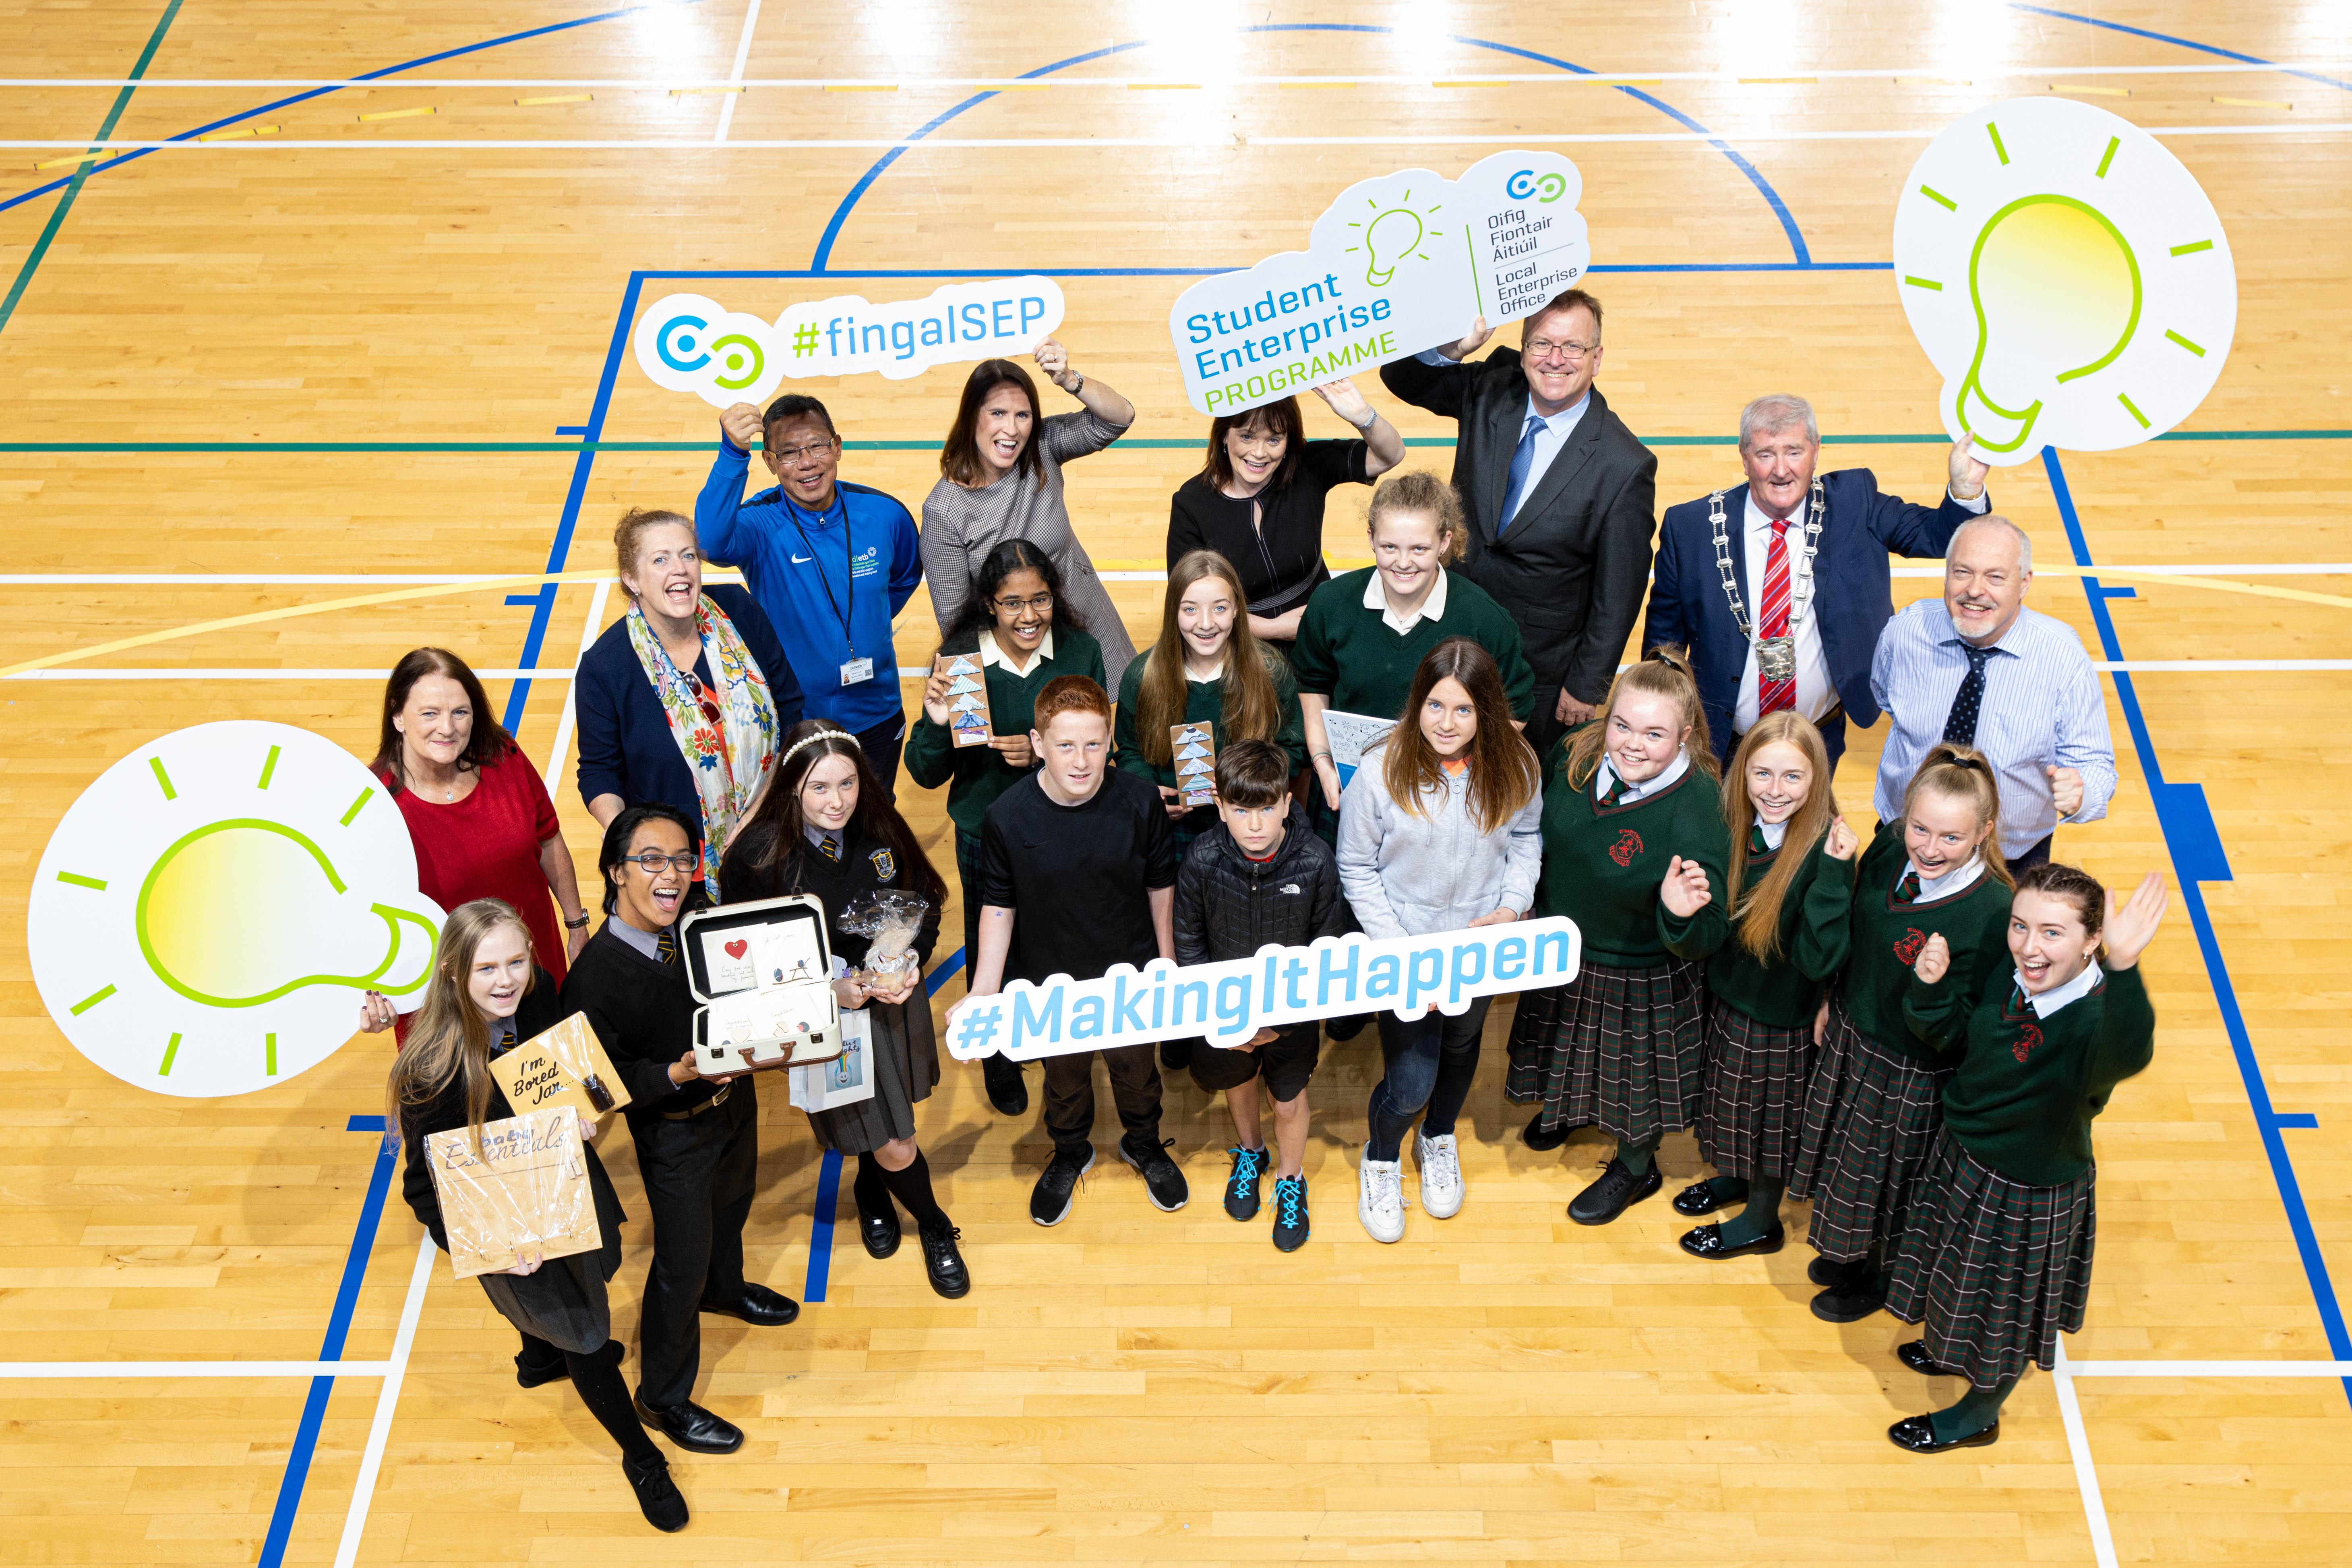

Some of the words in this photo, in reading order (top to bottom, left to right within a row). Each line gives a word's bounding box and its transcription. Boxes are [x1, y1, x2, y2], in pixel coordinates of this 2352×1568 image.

[1488, 210, 1525, 229] Oifig
[1491, 217, 1552, 246] Fiontair
[1494, 236, 1537, 262] Áitiúil
[1496, 262, 1537, 286] Local
[1498, 267, 1577, 300] Enterprise
[1186, 273, 1342, 344] Student
[1501, 294, 1545, 314] Office
[792, 297, 1045, 360] #fingalSEP
[1195, 298, 1392, 380] Enterprise
[1205, 331, 1397, 412] PROGRAMME
[852, 553, 869, 562] dletb
[958, 931, 1570, 1049] #MakingItHappen
[514, 1061, 559, 1097] Bored
[521, 1057, 546, 1076] I'm
[446, 1116, 564, 1170] Esentials
